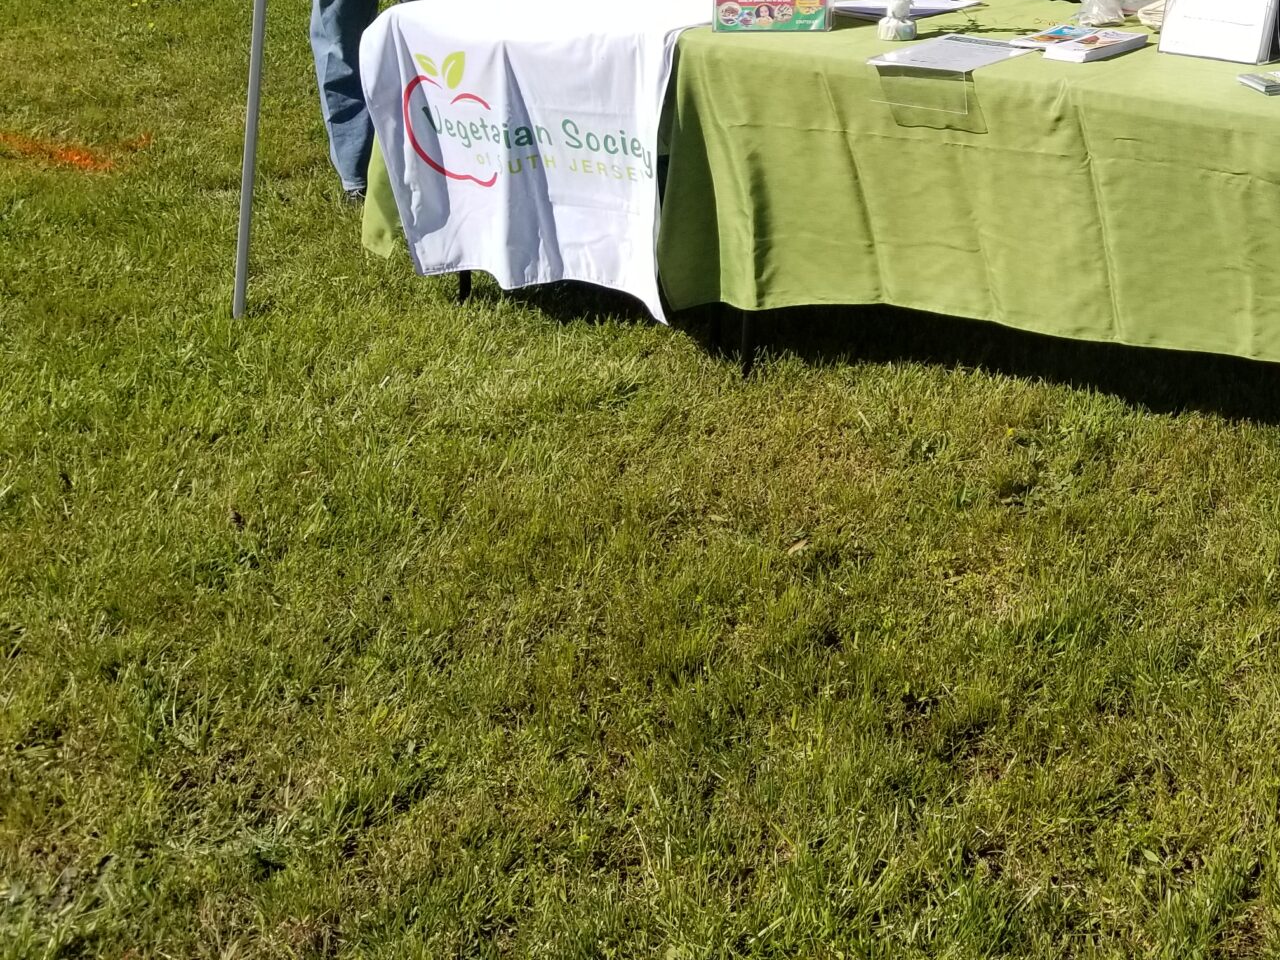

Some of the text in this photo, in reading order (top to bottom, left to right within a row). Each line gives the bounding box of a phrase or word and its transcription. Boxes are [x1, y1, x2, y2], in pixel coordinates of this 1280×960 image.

[422, 105, 655, 179] Vegetaian Sociey
[569, 157, 645, 182] JERSE
